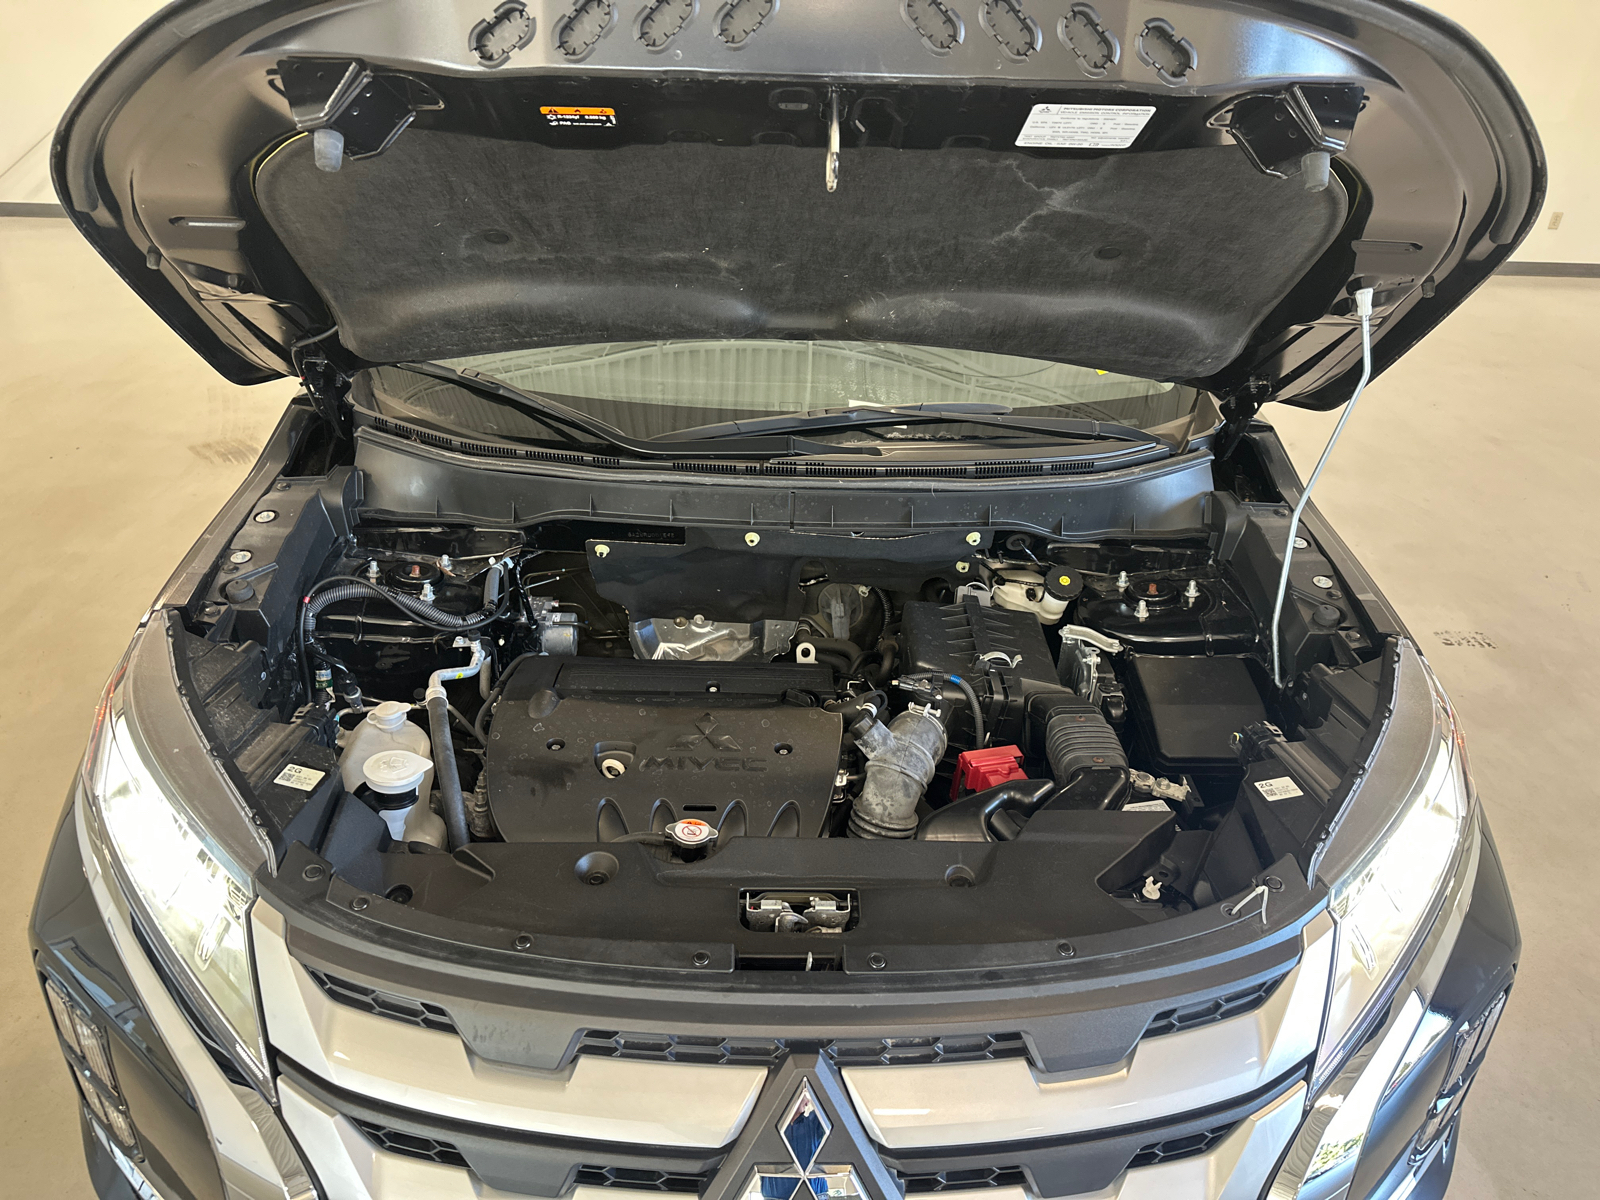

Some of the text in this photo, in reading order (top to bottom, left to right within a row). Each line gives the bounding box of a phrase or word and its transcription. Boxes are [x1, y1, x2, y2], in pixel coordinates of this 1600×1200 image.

[642, 755, 768, 772] MIVEC
[287, 766, 303, 774] 2G
[1258, 781, 1273, 789] 2G
